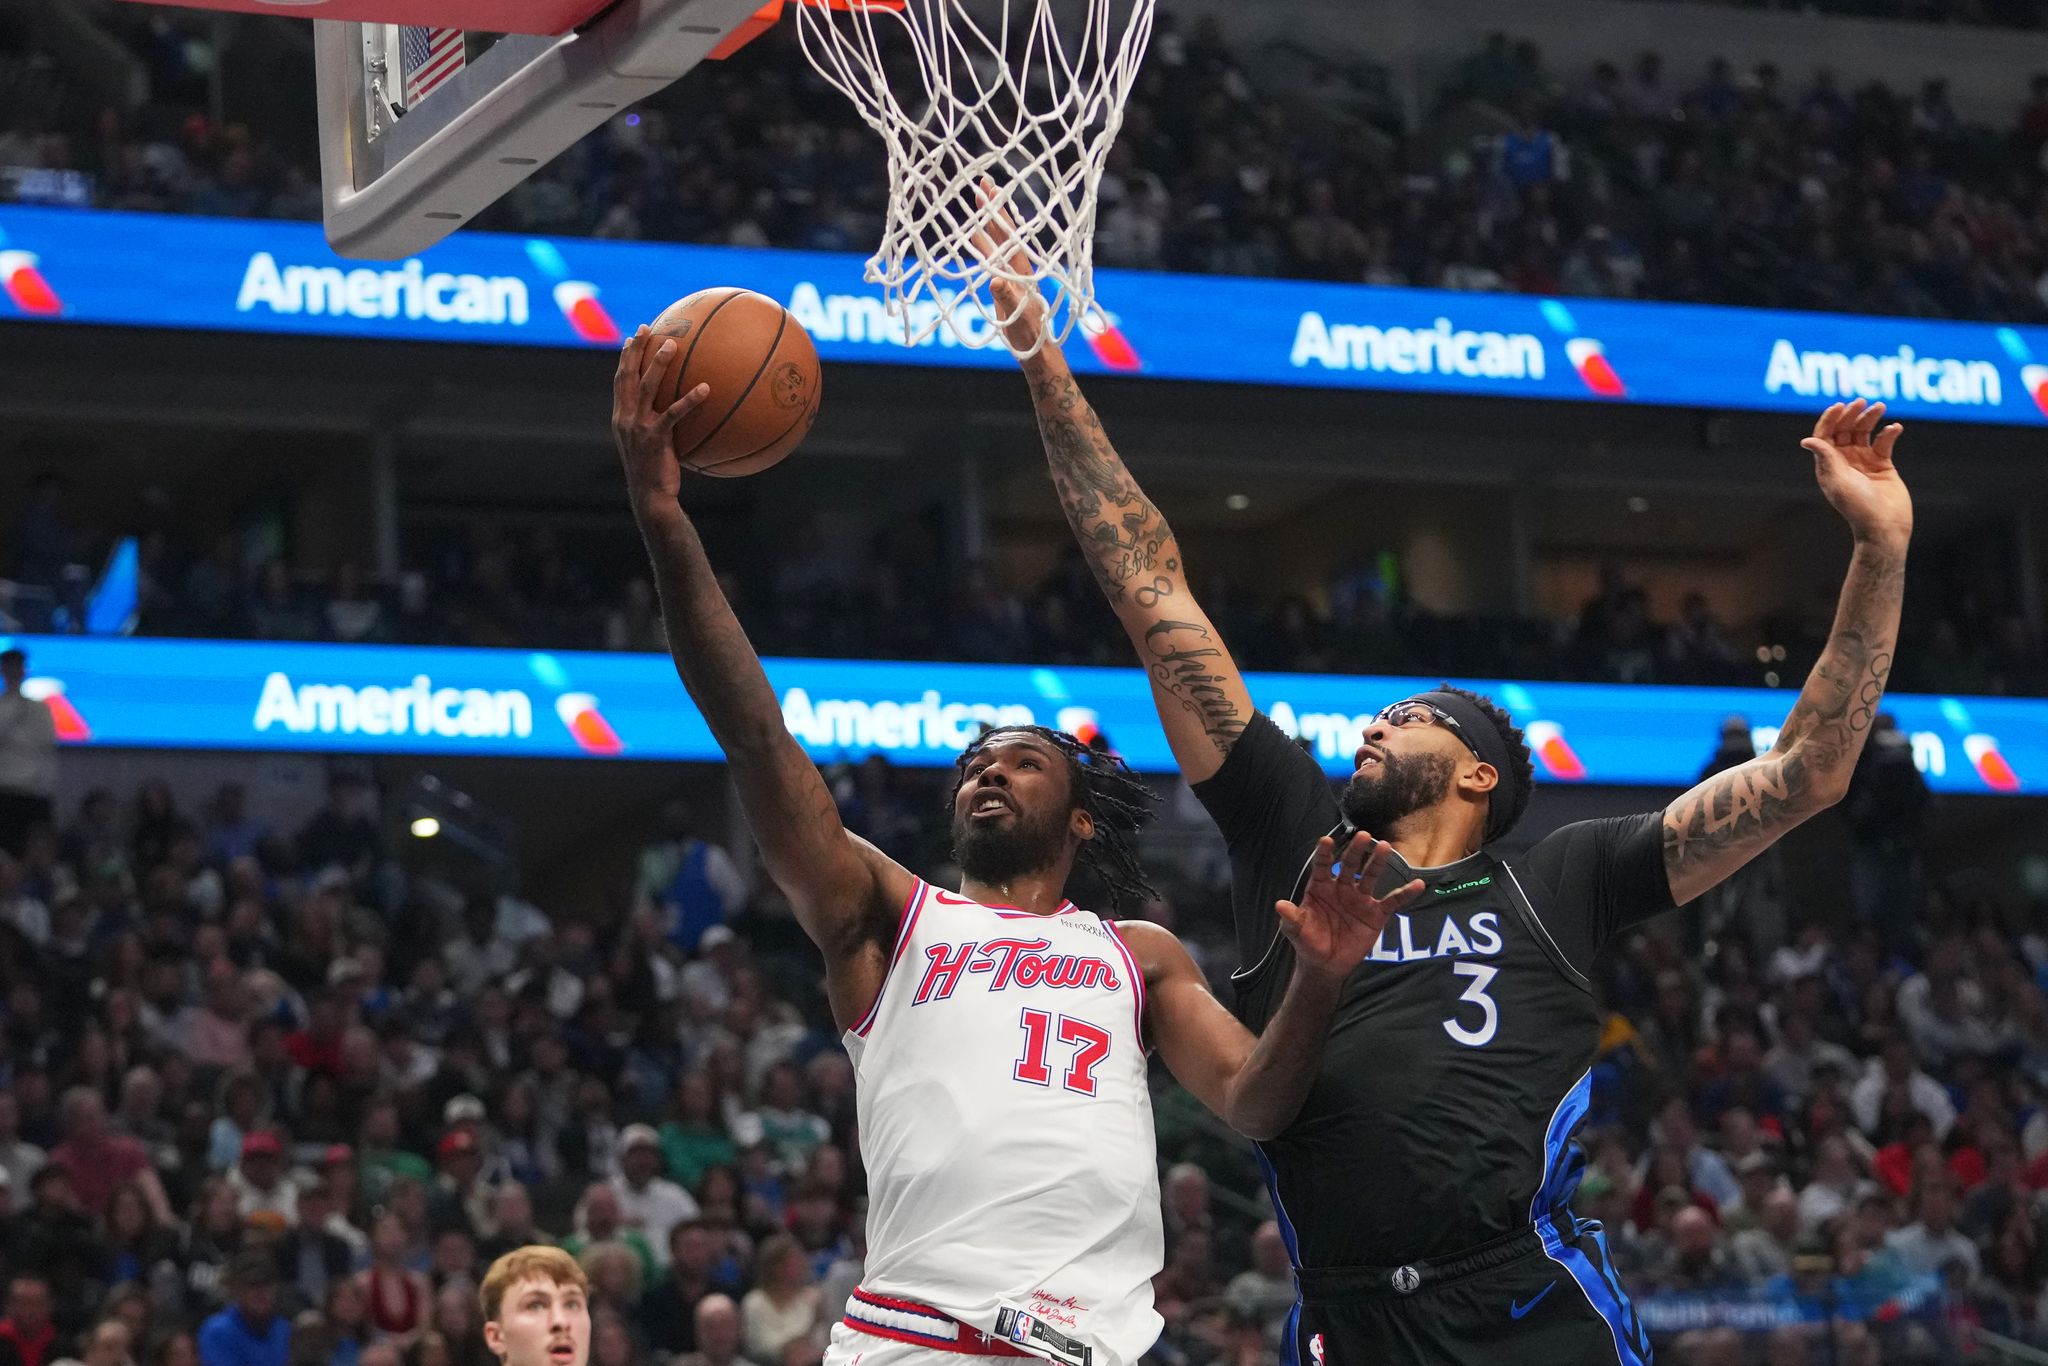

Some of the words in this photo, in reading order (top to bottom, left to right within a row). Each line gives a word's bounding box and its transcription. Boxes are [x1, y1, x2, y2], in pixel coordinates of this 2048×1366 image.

[236, 252, 529, 325] American
[1290, 311, 1545, 380] American
[1764, 339, 2002, 406] American
[253, 672, 532, 738] American
[1364, 911, 1503, 963] LLAS
[911, 937, 1121, 1007] H-Town
[1442, 960, 1500, 1047] 3
[1013, 1007, 1112, 1097] 17
